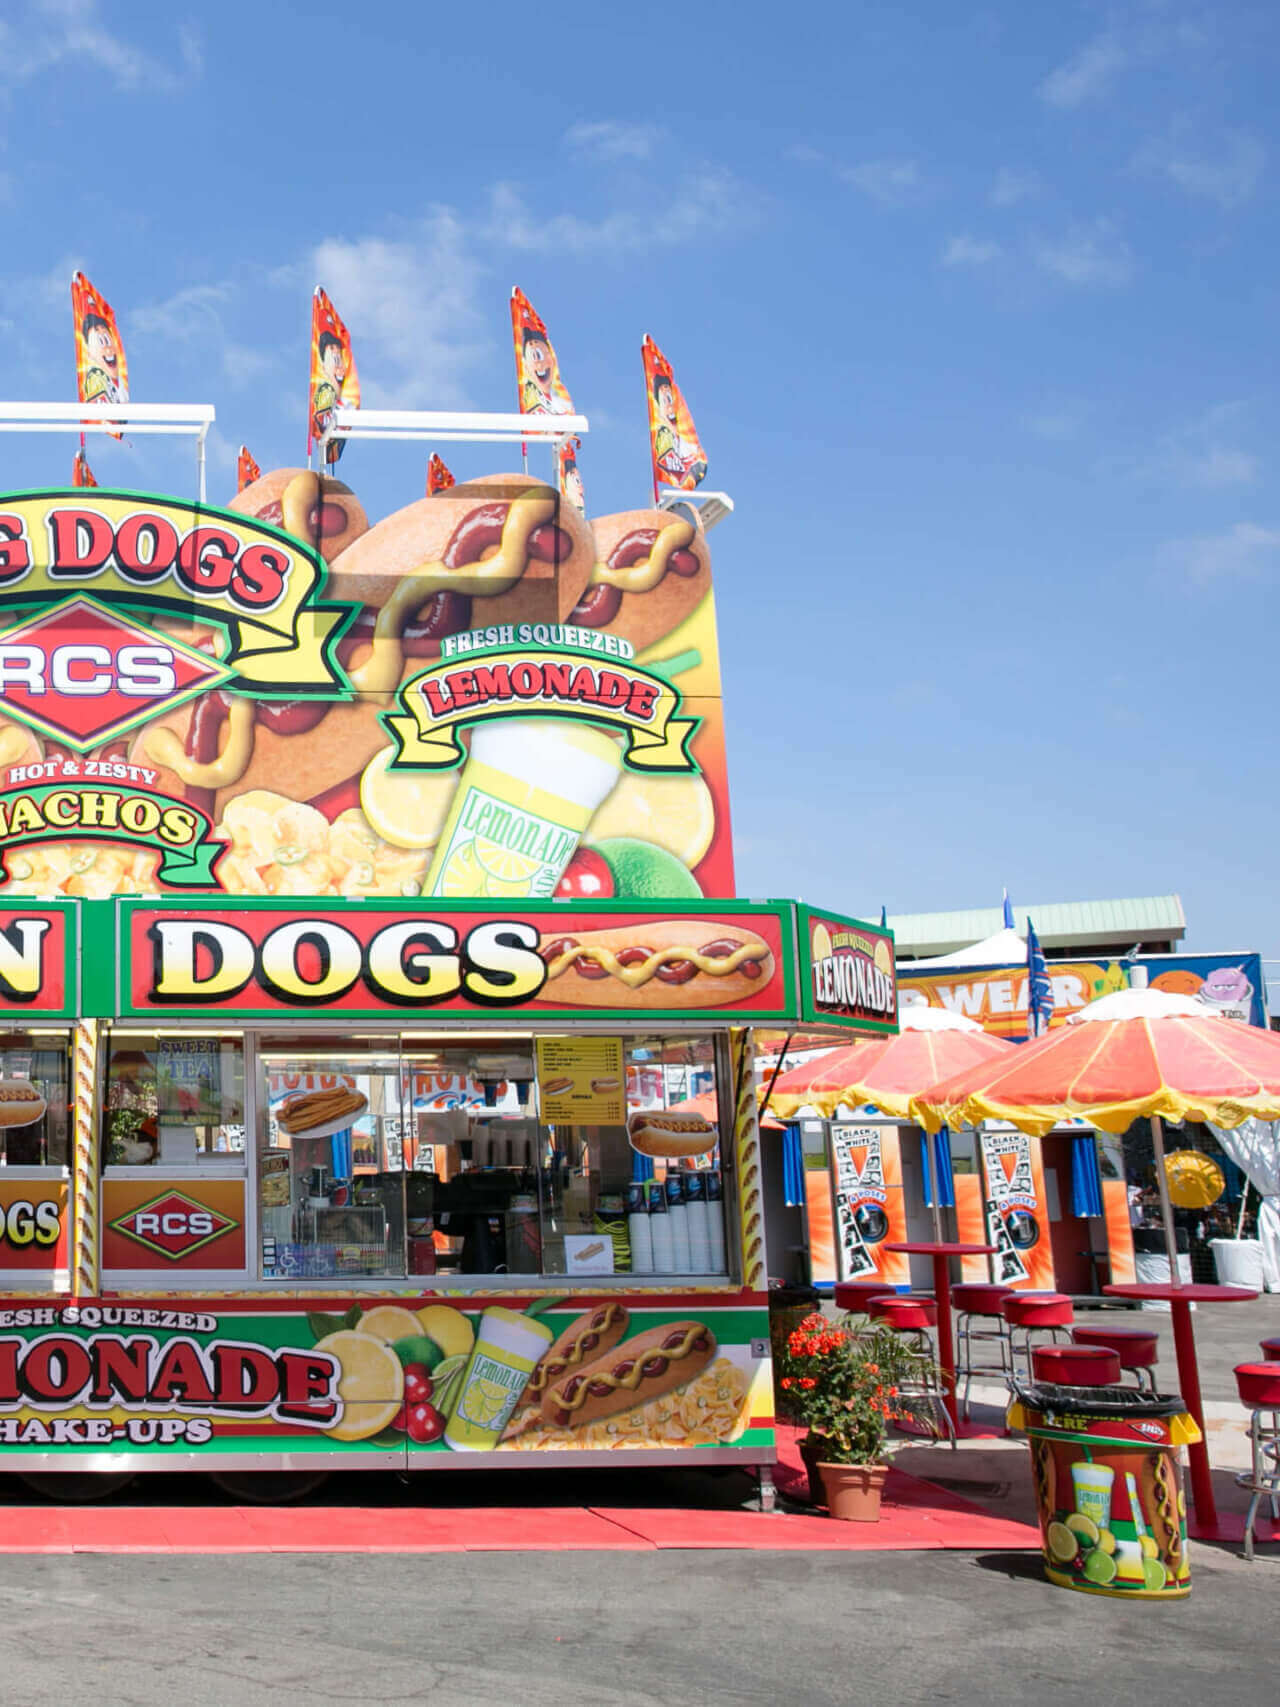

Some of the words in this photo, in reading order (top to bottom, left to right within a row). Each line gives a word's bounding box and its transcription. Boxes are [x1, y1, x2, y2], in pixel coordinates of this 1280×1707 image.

[51, 510, 289, 607] DOGS
[444, 626, 516, 659] FRESH
[520, 626, 634, 661] SQUEEZED
[423, 663, 661, 719] LEMONADE
[10, 762, 58, 784] HOT
[62, 761, 79, 776] &
[85, 760, 156, 785] ZESTY
[150, 918, 547, 1002] DOGS
[812, 954, 895, 1014] LEMONADE
[160, 1040, 218, 1054] SWEET
[168, 1059, 213, 1080] TEA
[843, 1128, 870, 1138] BLACK
[845, 1138, 870, 1147] WHITE
[993, 1136, 1019, 1145] BLACK
[994, 1145, 1019, 1154] WHITE
[135, 1212, 214, 1236] RCS
[61, 1306, 218, 1333] SQUEEZED
